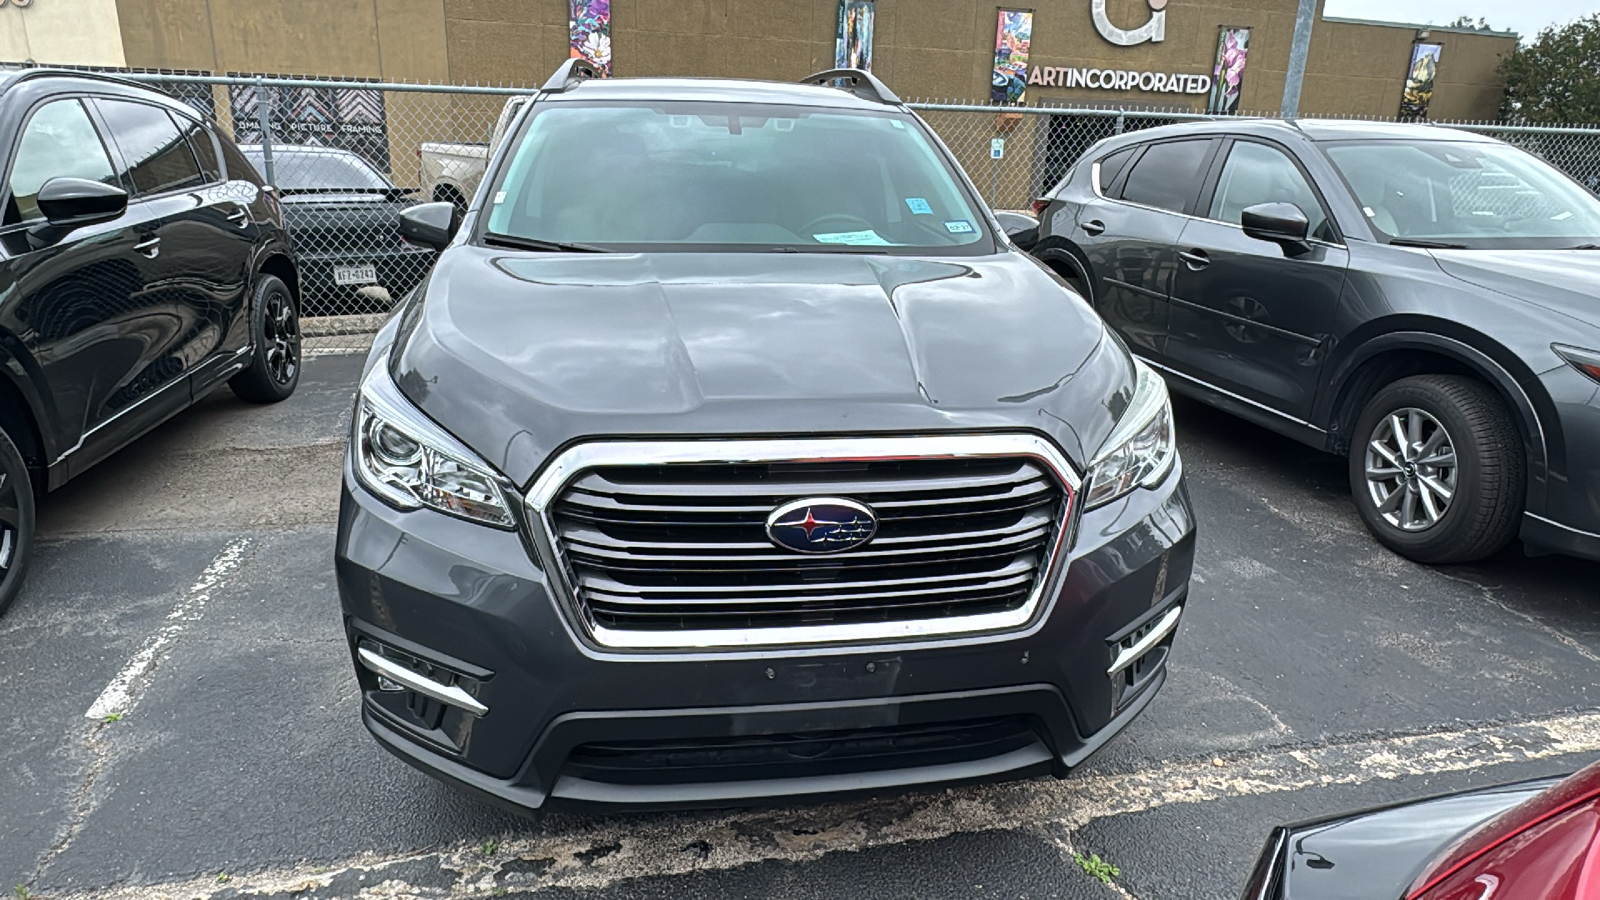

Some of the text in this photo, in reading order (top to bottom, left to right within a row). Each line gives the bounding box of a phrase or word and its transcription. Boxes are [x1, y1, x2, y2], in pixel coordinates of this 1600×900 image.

[238, 121, 382, 133] AMANG PICTURE FRAMING
